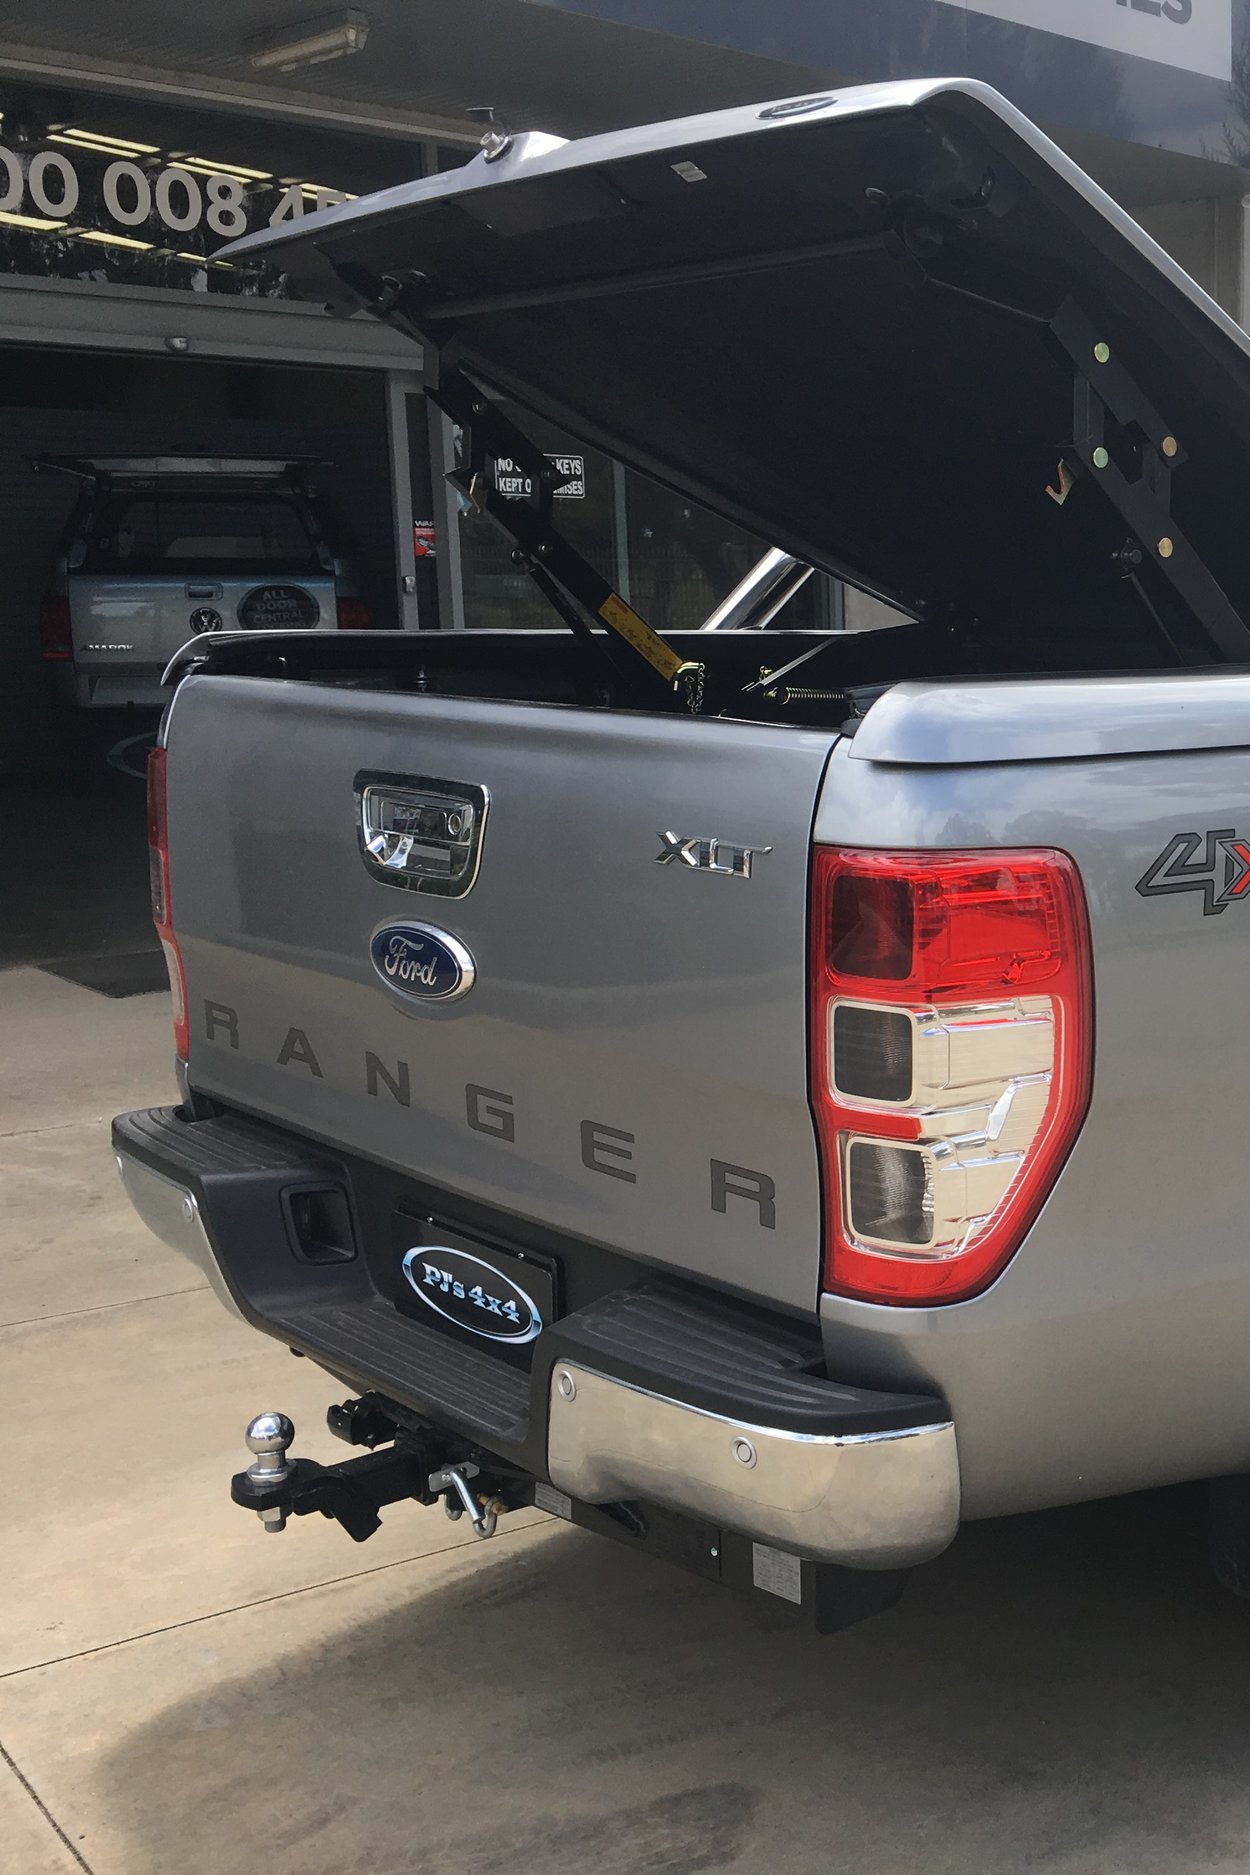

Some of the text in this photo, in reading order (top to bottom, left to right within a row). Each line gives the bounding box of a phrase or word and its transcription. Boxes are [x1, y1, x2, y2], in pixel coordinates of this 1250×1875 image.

[103, 160, 248, 237] 008
[498, 458, 513, 472] NO
[556, 459, 582, 475] KEYS
[499, 477, 523, 492] KEPT
[263, 589, 289, 601] ALL
[653, 830, 774, 878] XLT
[384, 935, 438, 986] Ford
[204, 1000, 776, 1229] RANGER
